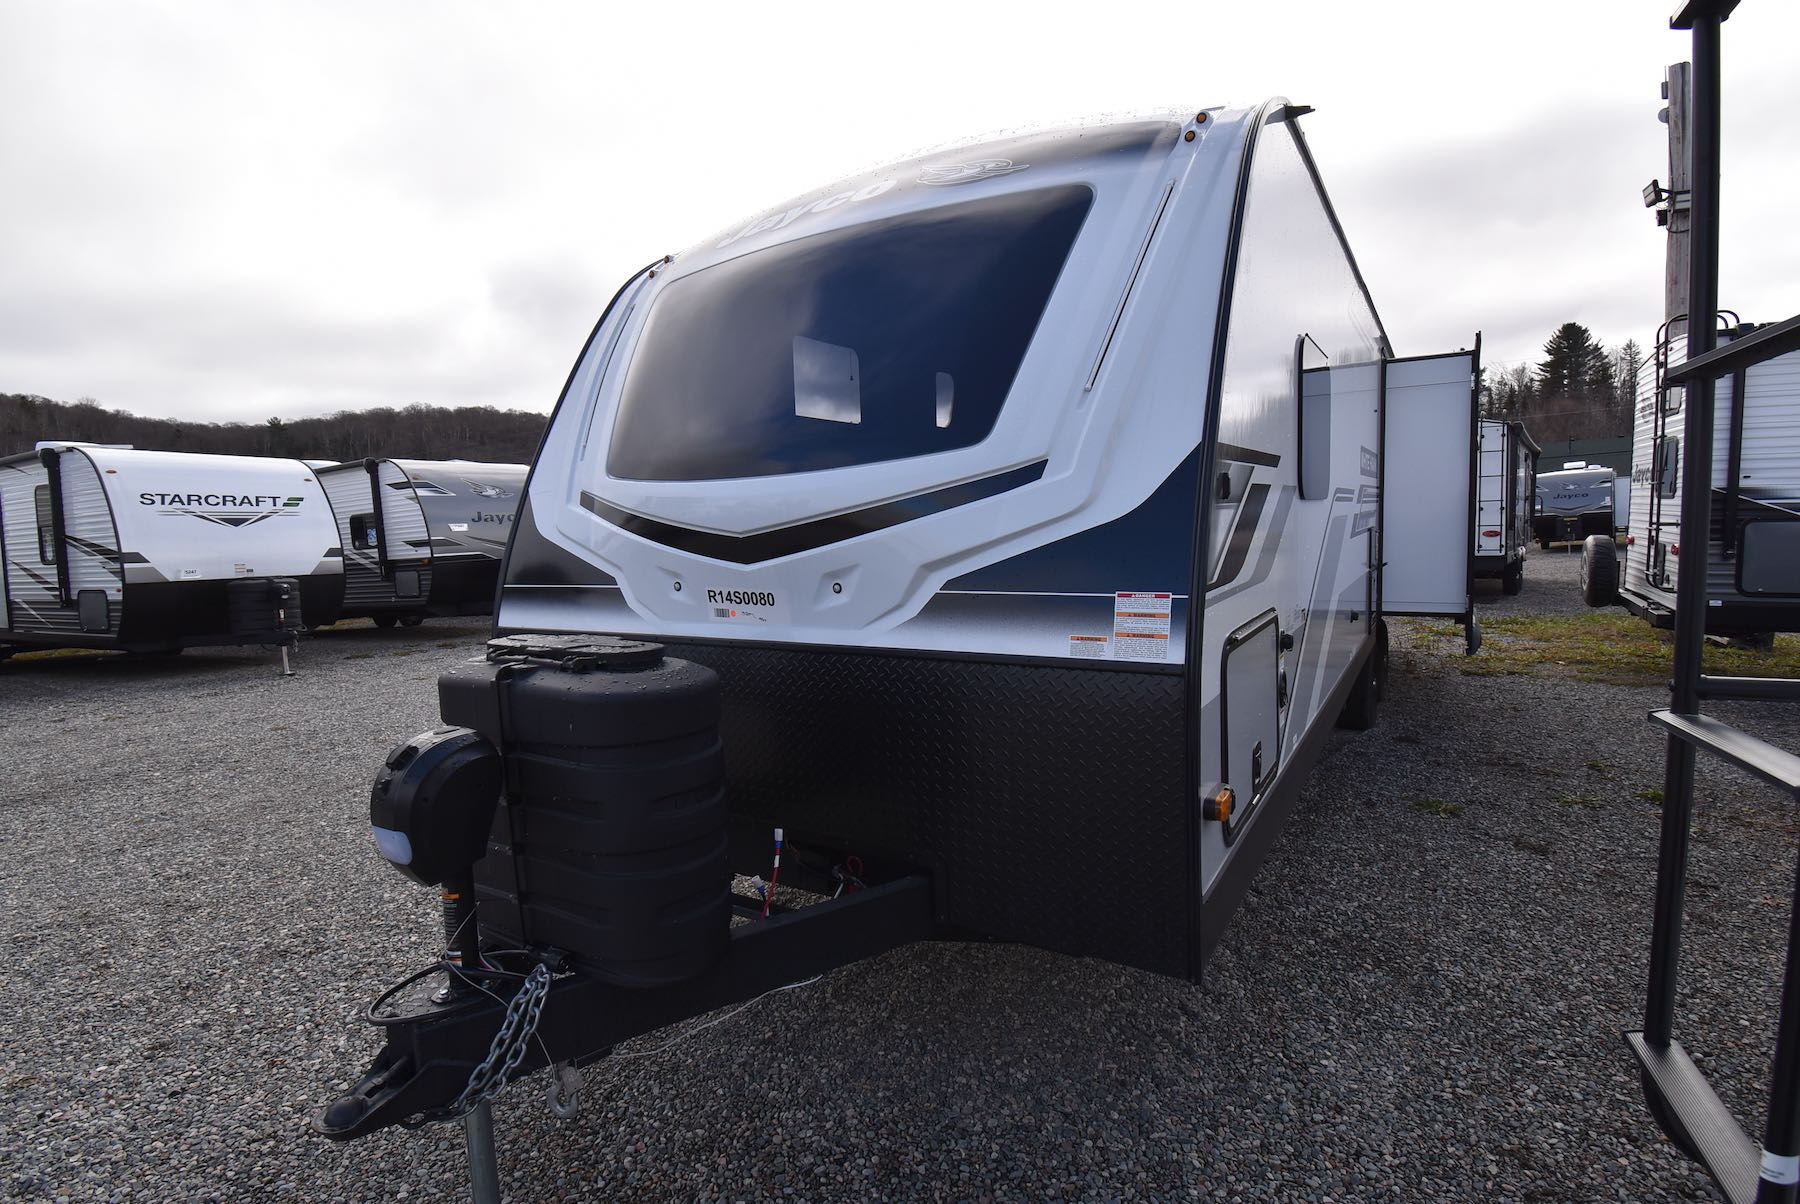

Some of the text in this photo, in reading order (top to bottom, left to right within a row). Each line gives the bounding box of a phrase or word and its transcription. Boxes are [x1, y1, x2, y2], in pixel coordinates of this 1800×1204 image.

[139, 492, 281, 508] STARCRAFT
[471, 511, 516, 525] Jayc
[707, 589, 775, 607] R14S0080
